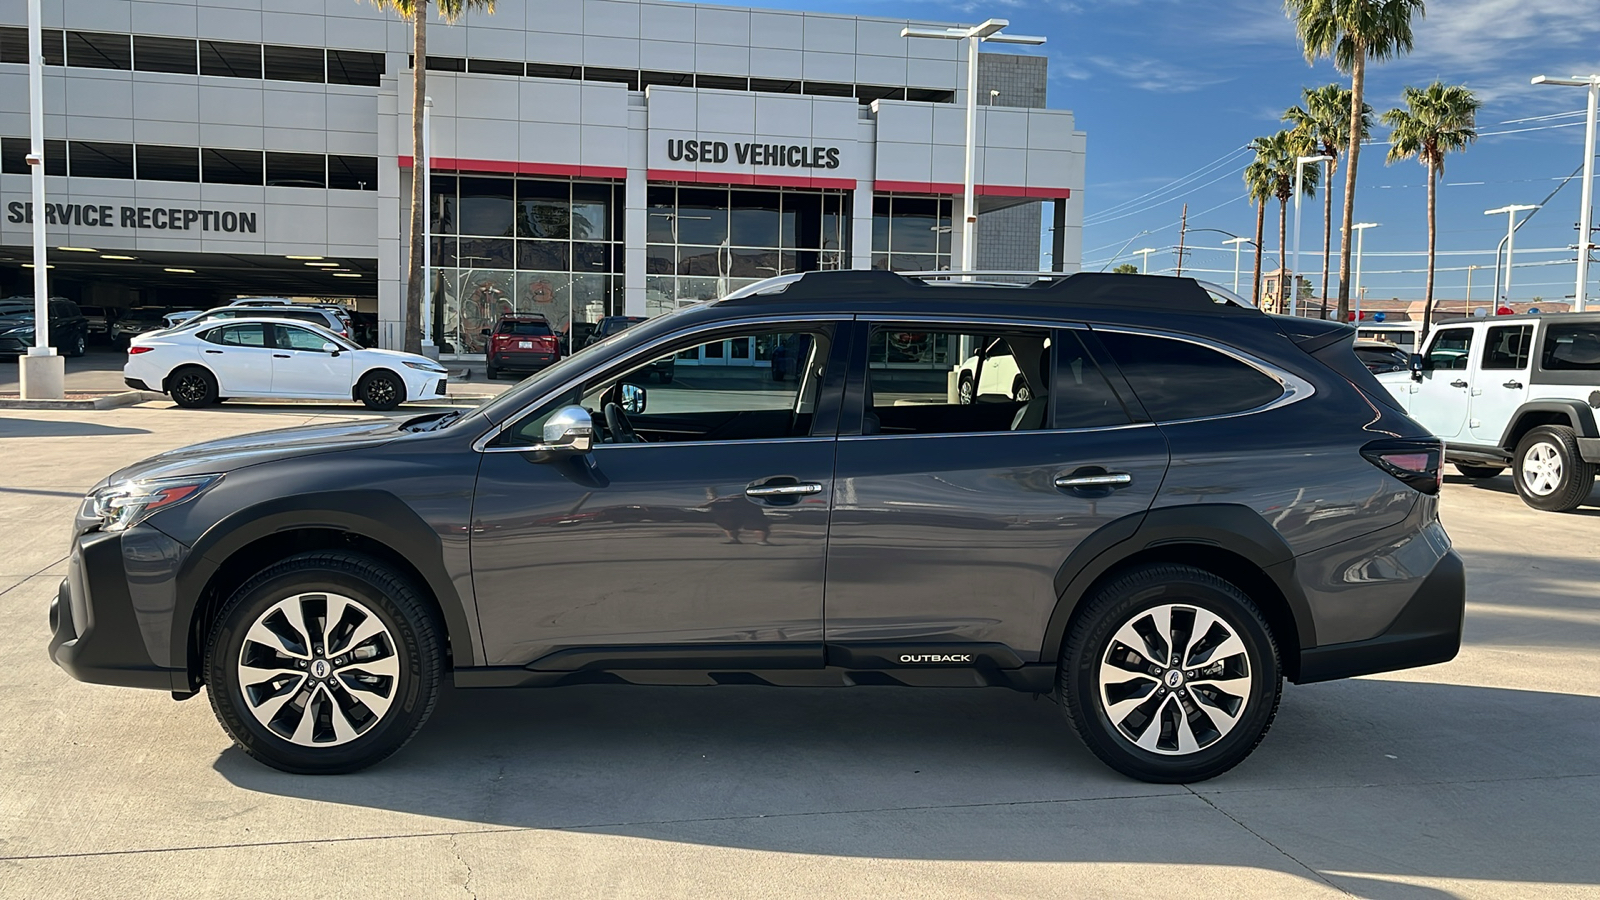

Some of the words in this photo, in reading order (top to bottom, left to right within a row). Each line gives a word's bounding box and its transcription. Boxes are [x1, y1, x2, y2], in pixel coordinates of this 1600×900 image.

[668, 139, 728, 163] USED
[735, 143, 840, 169] VEHICLES
[120, 206, 257, 233] RECEPTION
[1088, 602, 1130, 648] MICHELIN
[394, 614, 420, 674] MICHELIN
[900, 654, 971, 663] OUTBACK
